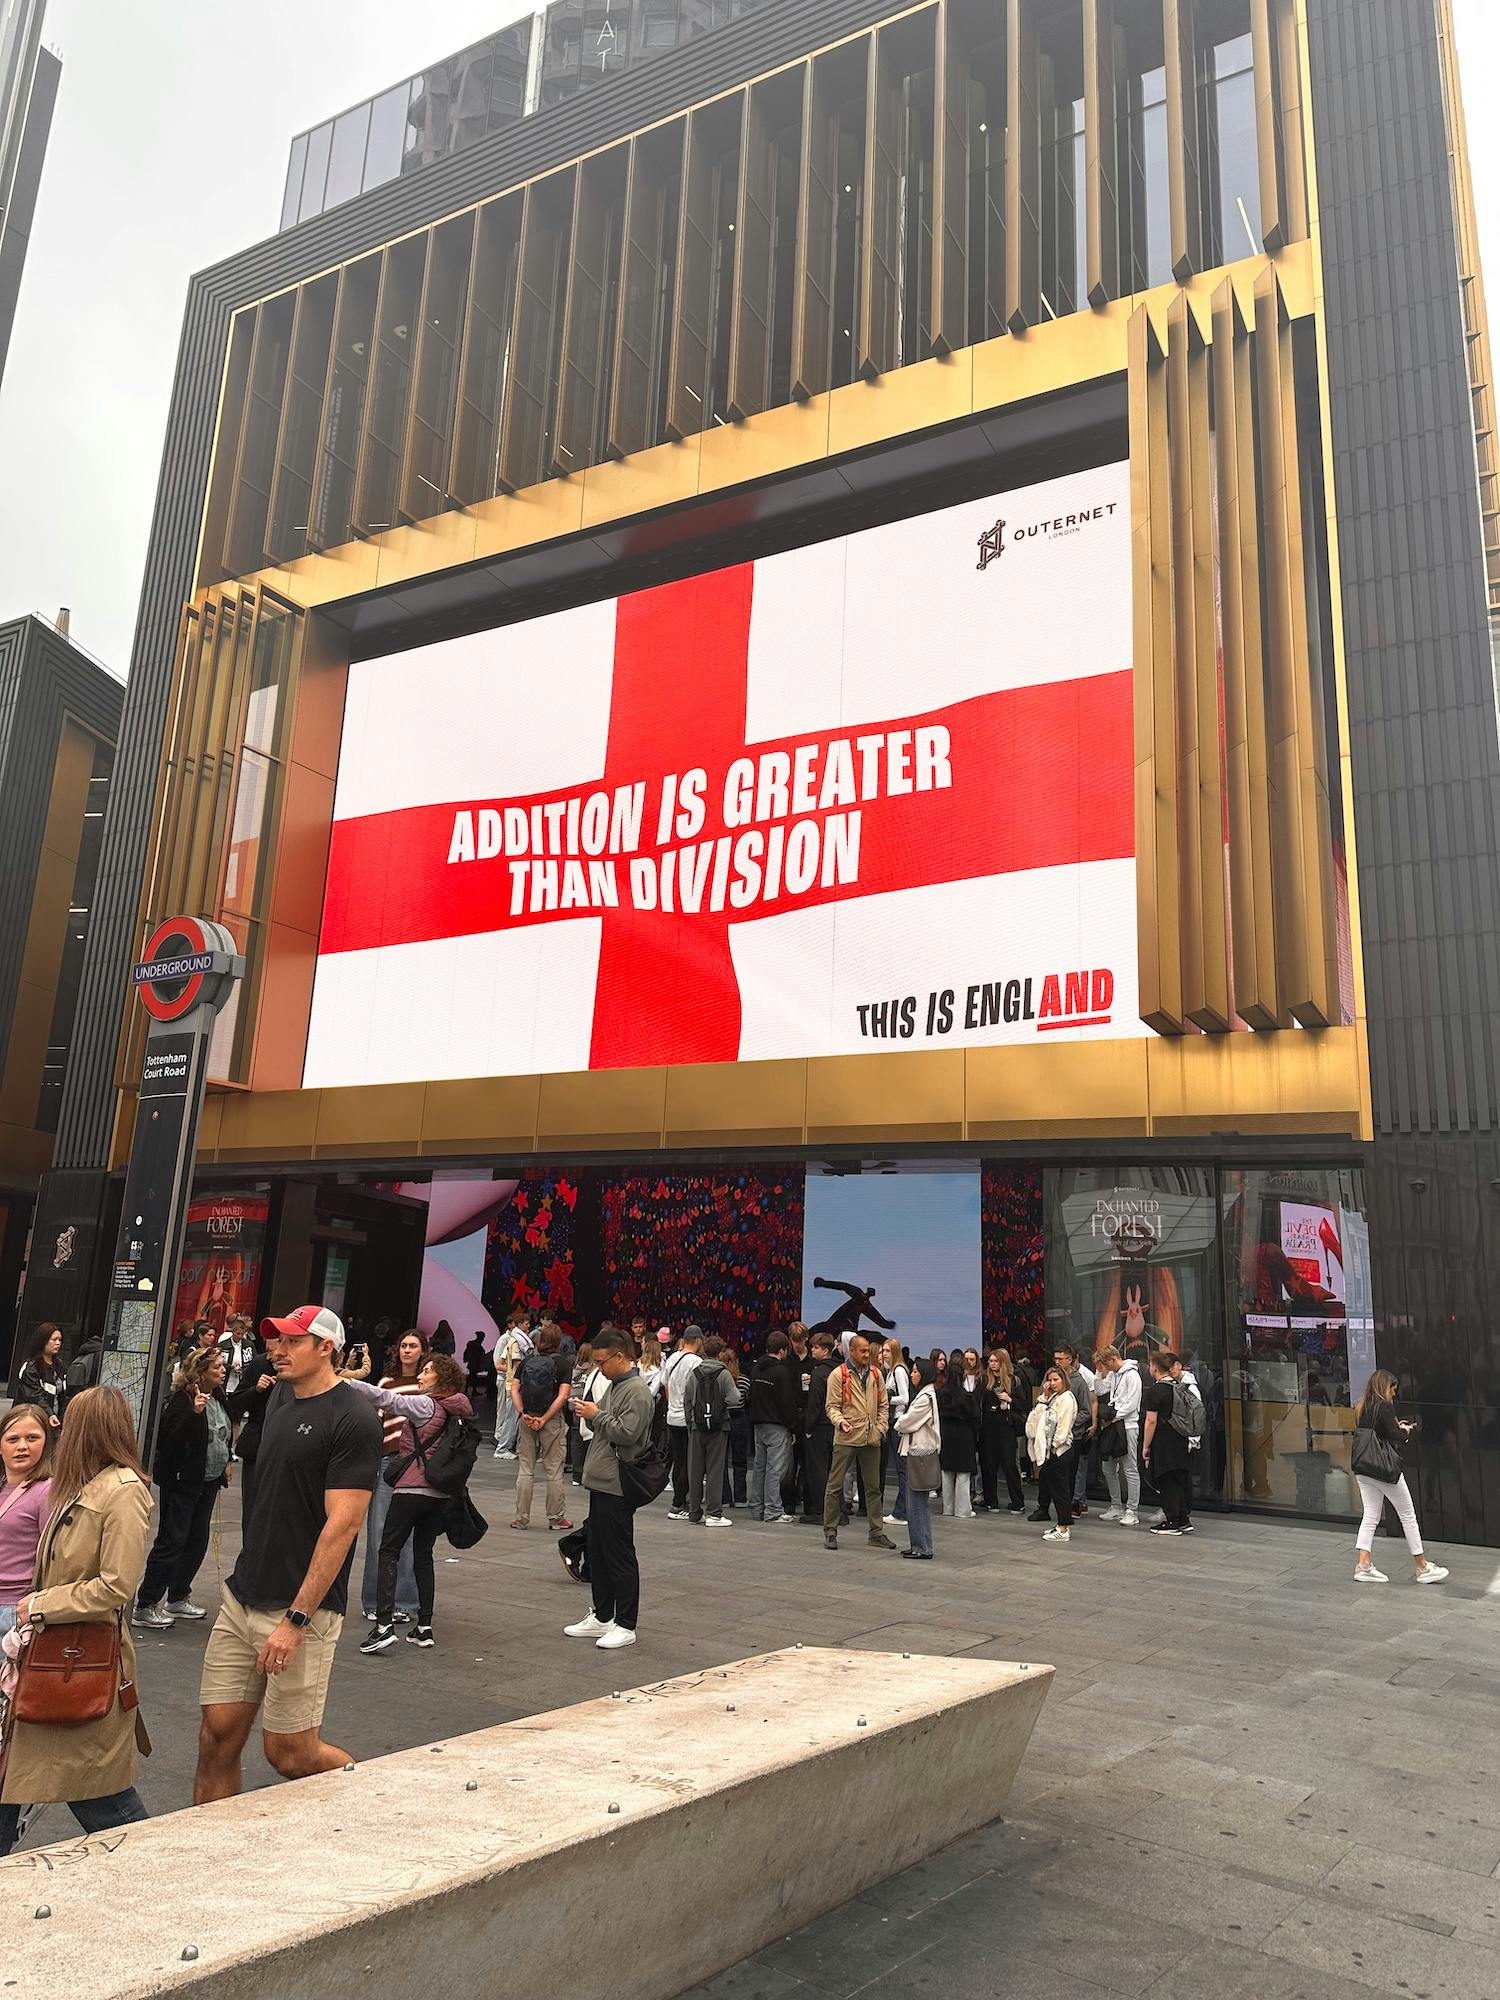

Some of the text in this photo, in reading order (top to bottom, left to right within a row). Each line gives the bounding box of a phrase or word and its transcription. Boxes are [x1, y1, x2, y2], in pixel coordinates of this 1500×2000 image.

[1014, 503, 1117, 541] OUTERNET
[1048, 527, 1080, 540] LONDON
[446, 724, 953, 864] ADDITION IS GREATER
[508, 810, 862, 916] THAN DIVISION
[135, 956, 212, 979] UNDERGROUND
[857, 968, 1114, 1038] THIS IS ENGLAND
[147, 1053, 187, 1066] Tottenham
[144, 1065, 186, 1079] Court Road
[211, 1206, 243, 1216] ENCHANTED
[1096, 1200, 1160, 1212] ENCHANTED
[206, 1216, 245, 1233] FOREST
[1091, 1214, 1164, 1238] FOREST
